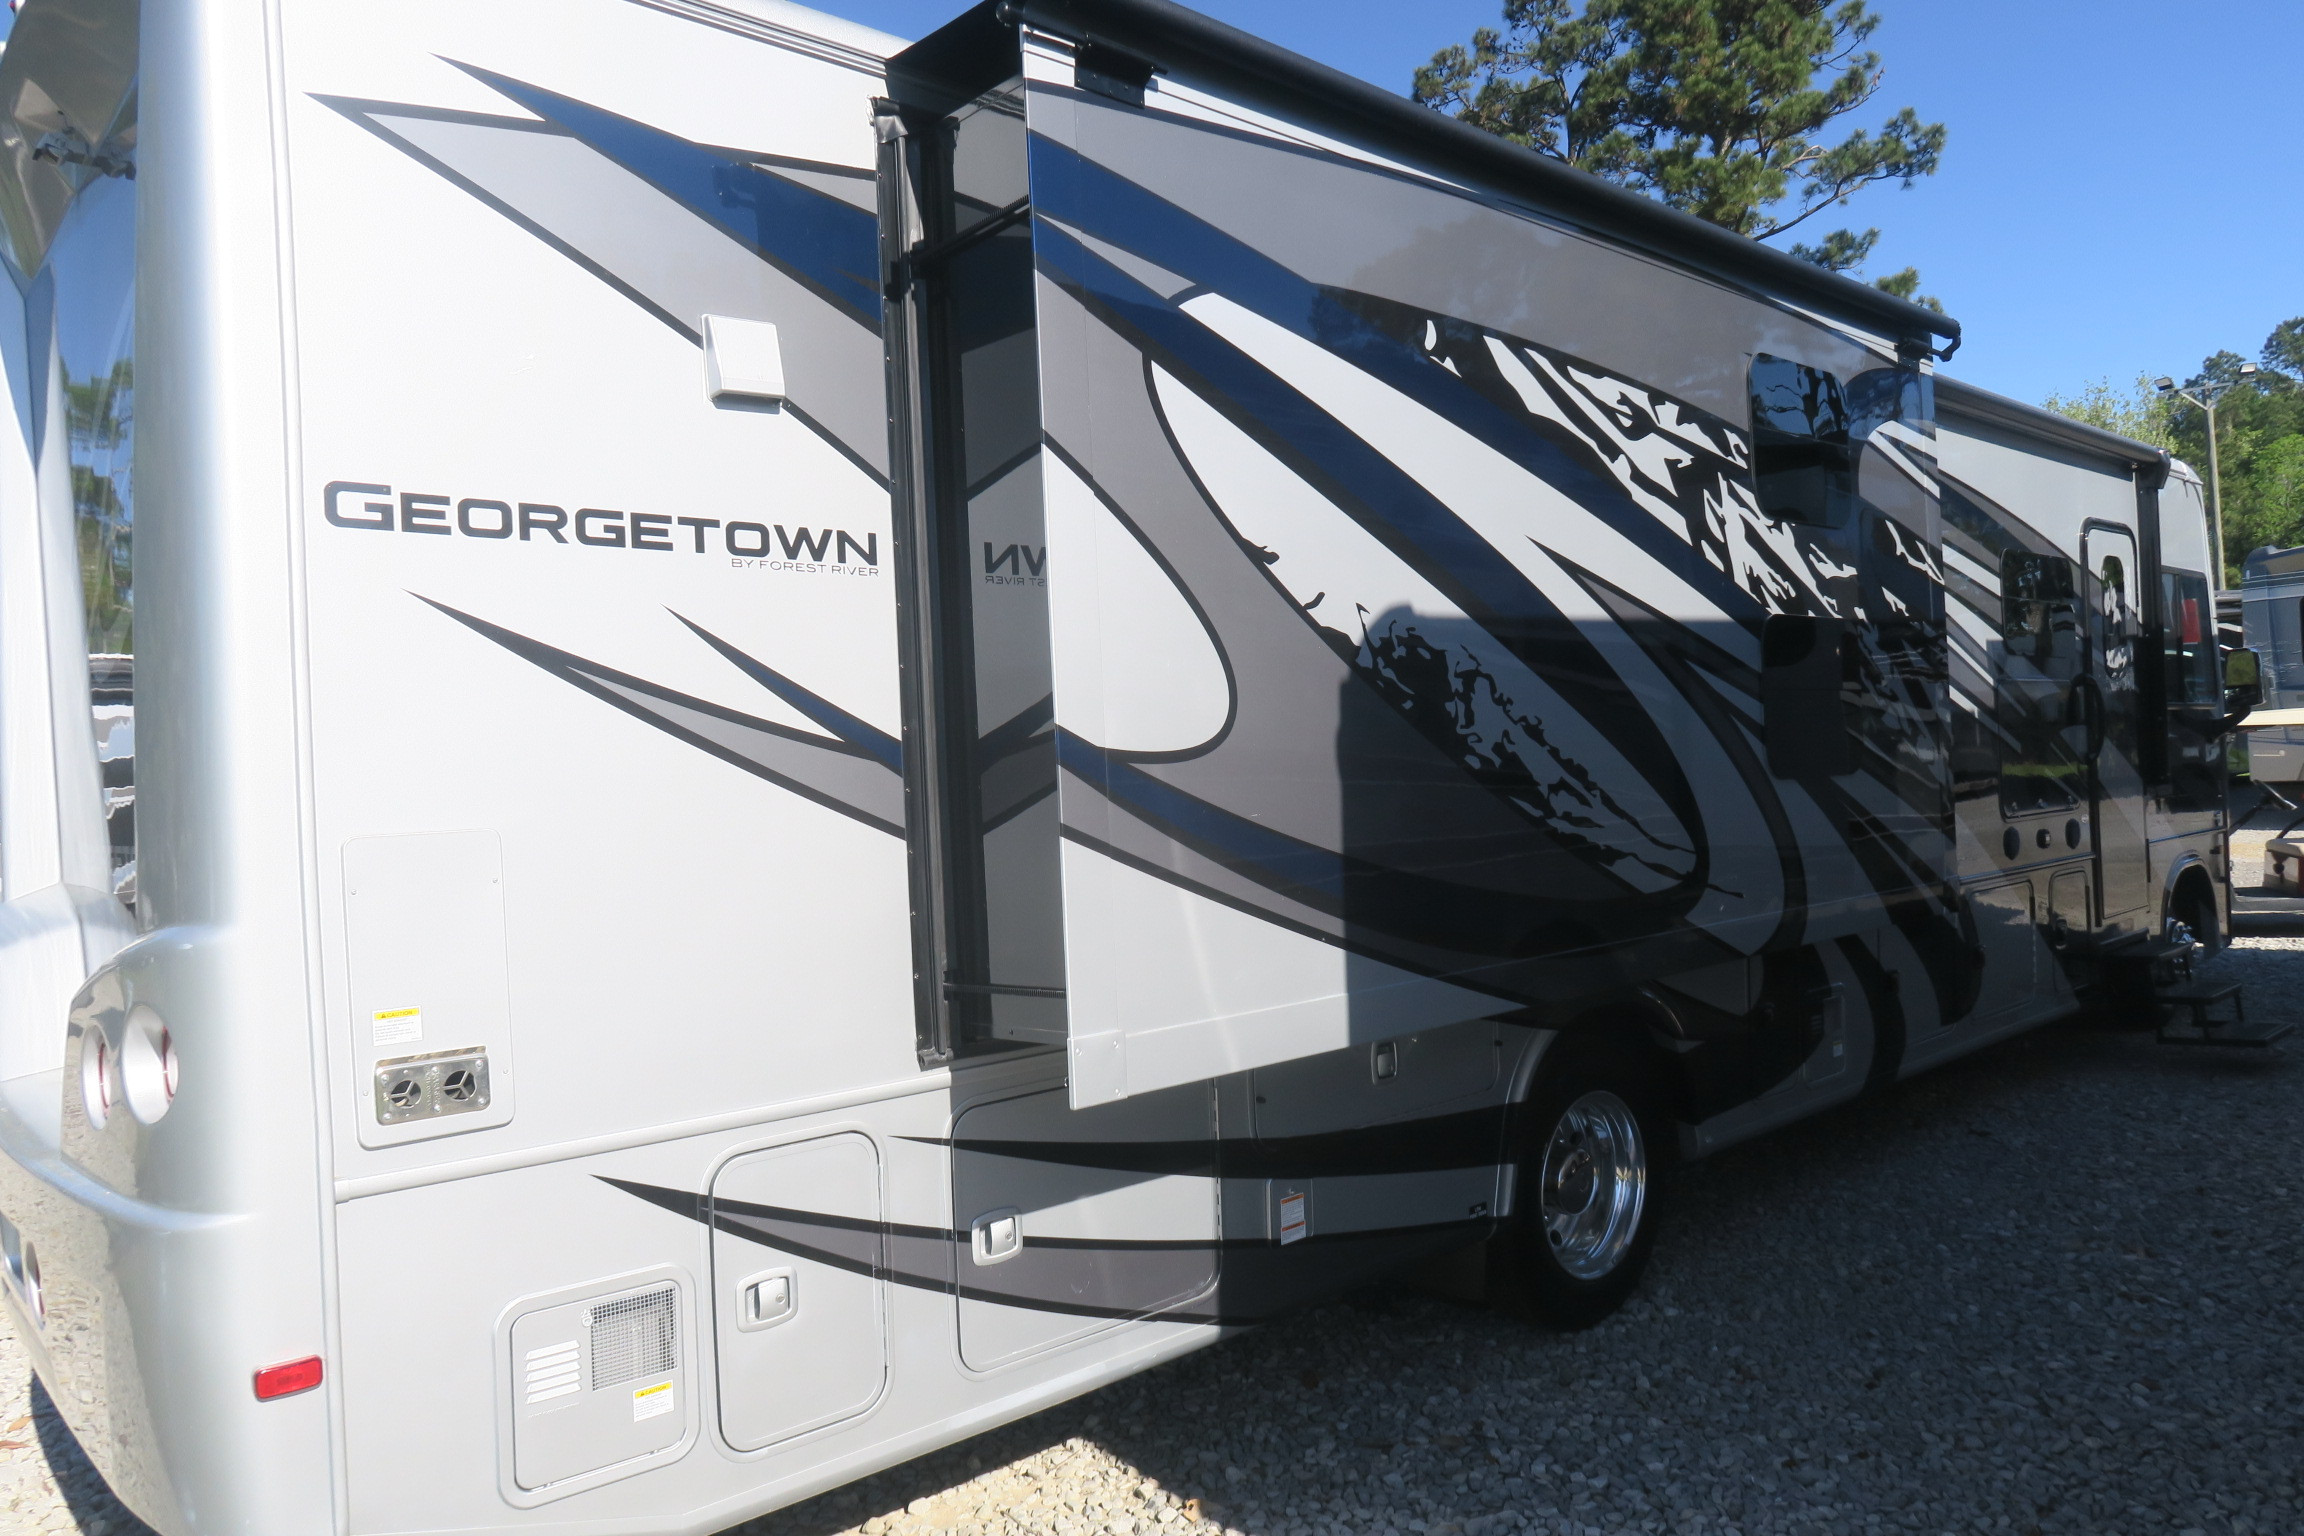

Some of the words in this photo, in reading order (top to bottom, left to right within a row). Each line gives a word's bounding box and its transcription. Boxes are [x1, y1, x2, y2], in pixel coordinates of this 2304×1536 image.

[323, 480, 878, 566] GEORGETOWN
[731, 558, 754, 569] BY
[759, 560, 827, 574] FOREST
[831, 565, 880, 577] RIVER
[387, 1010, 413, 1018] CAUTION
[645, 1385, 667, 1395] CAUTION
